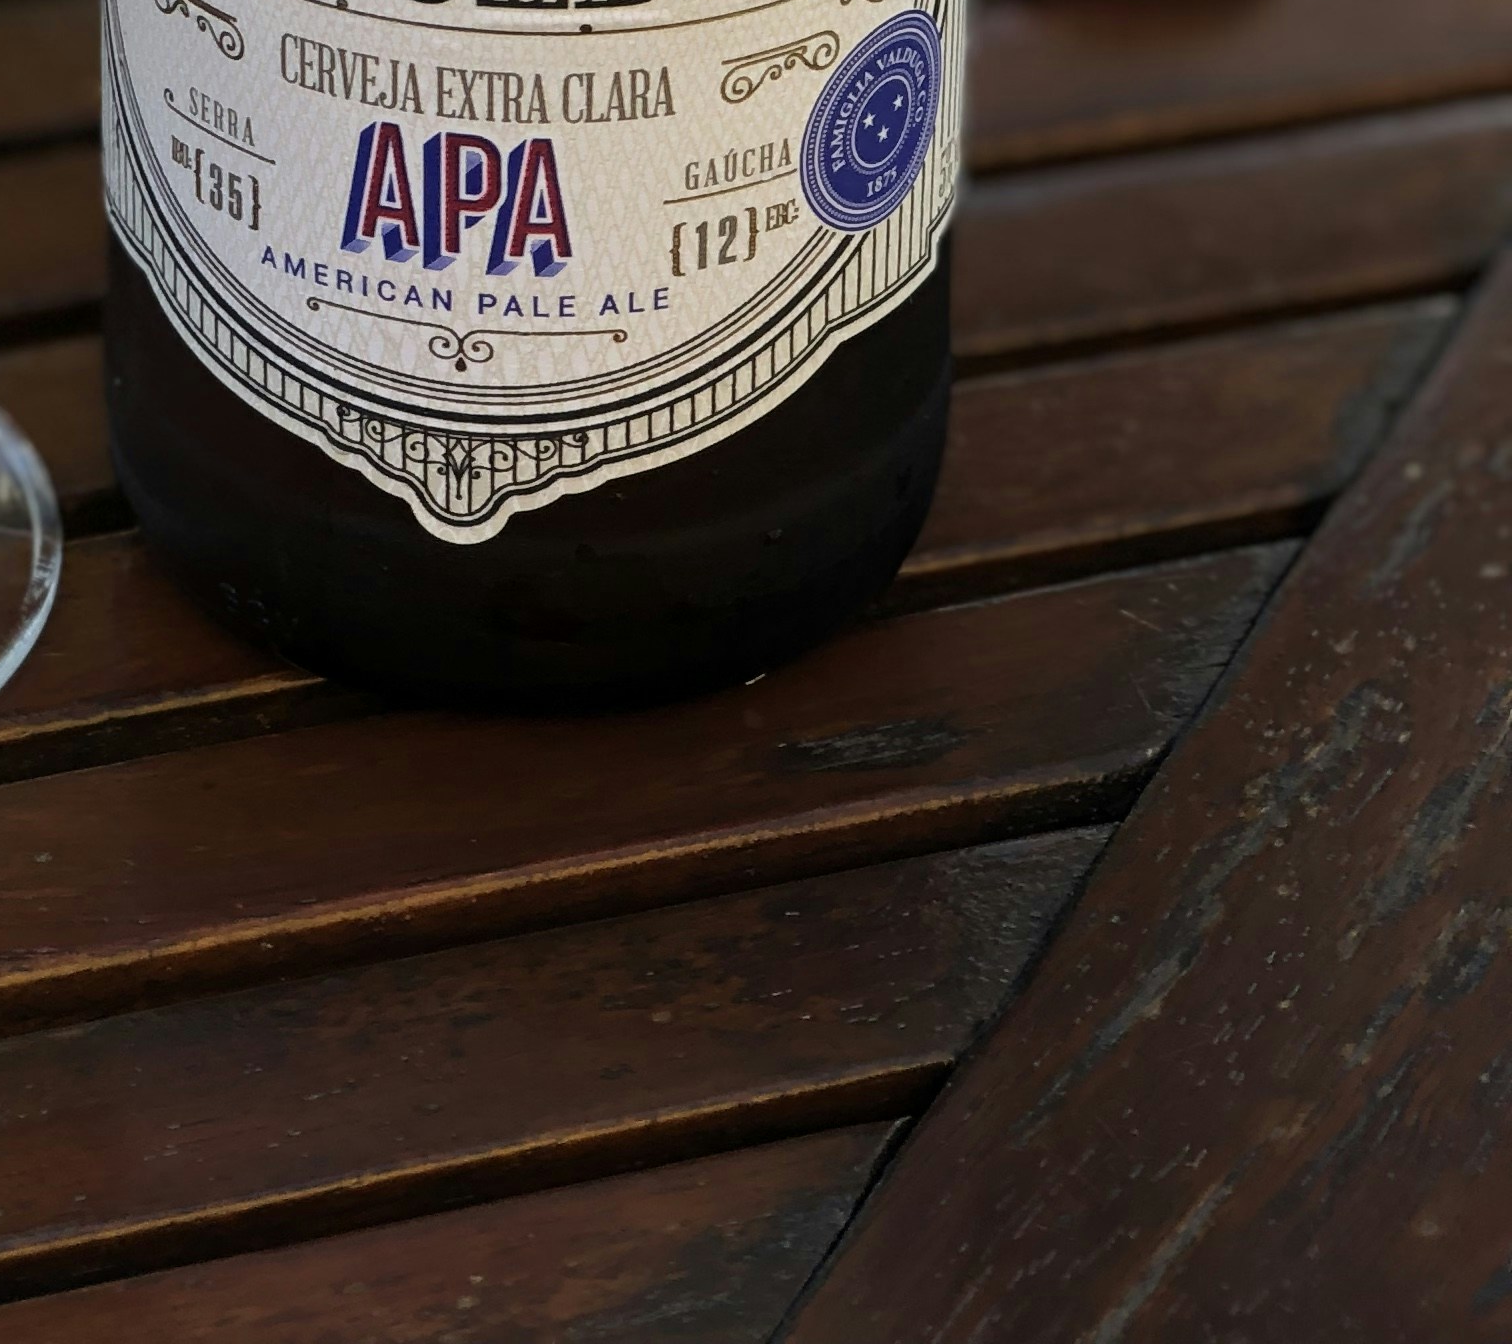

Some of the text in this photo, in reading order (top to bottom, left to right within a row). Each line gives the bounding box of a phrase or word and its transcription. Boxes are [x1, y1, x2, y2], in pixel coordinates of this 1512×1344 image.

[280, 32, 676, 125] CERVEJA EXTRA CLARA
[831, 71, 875, 173] FAMIGLIA
[877, 46, 925, 89] VALDUGA
[189, 87, 255, 147] SERRA
[341, 121, 573, 278] APA
[684, 138, 793, 190] GAÚCHA
[865, 167, 898, 198] 1875
[261, 245, 669, 318] AMERICAN PALE ALE
